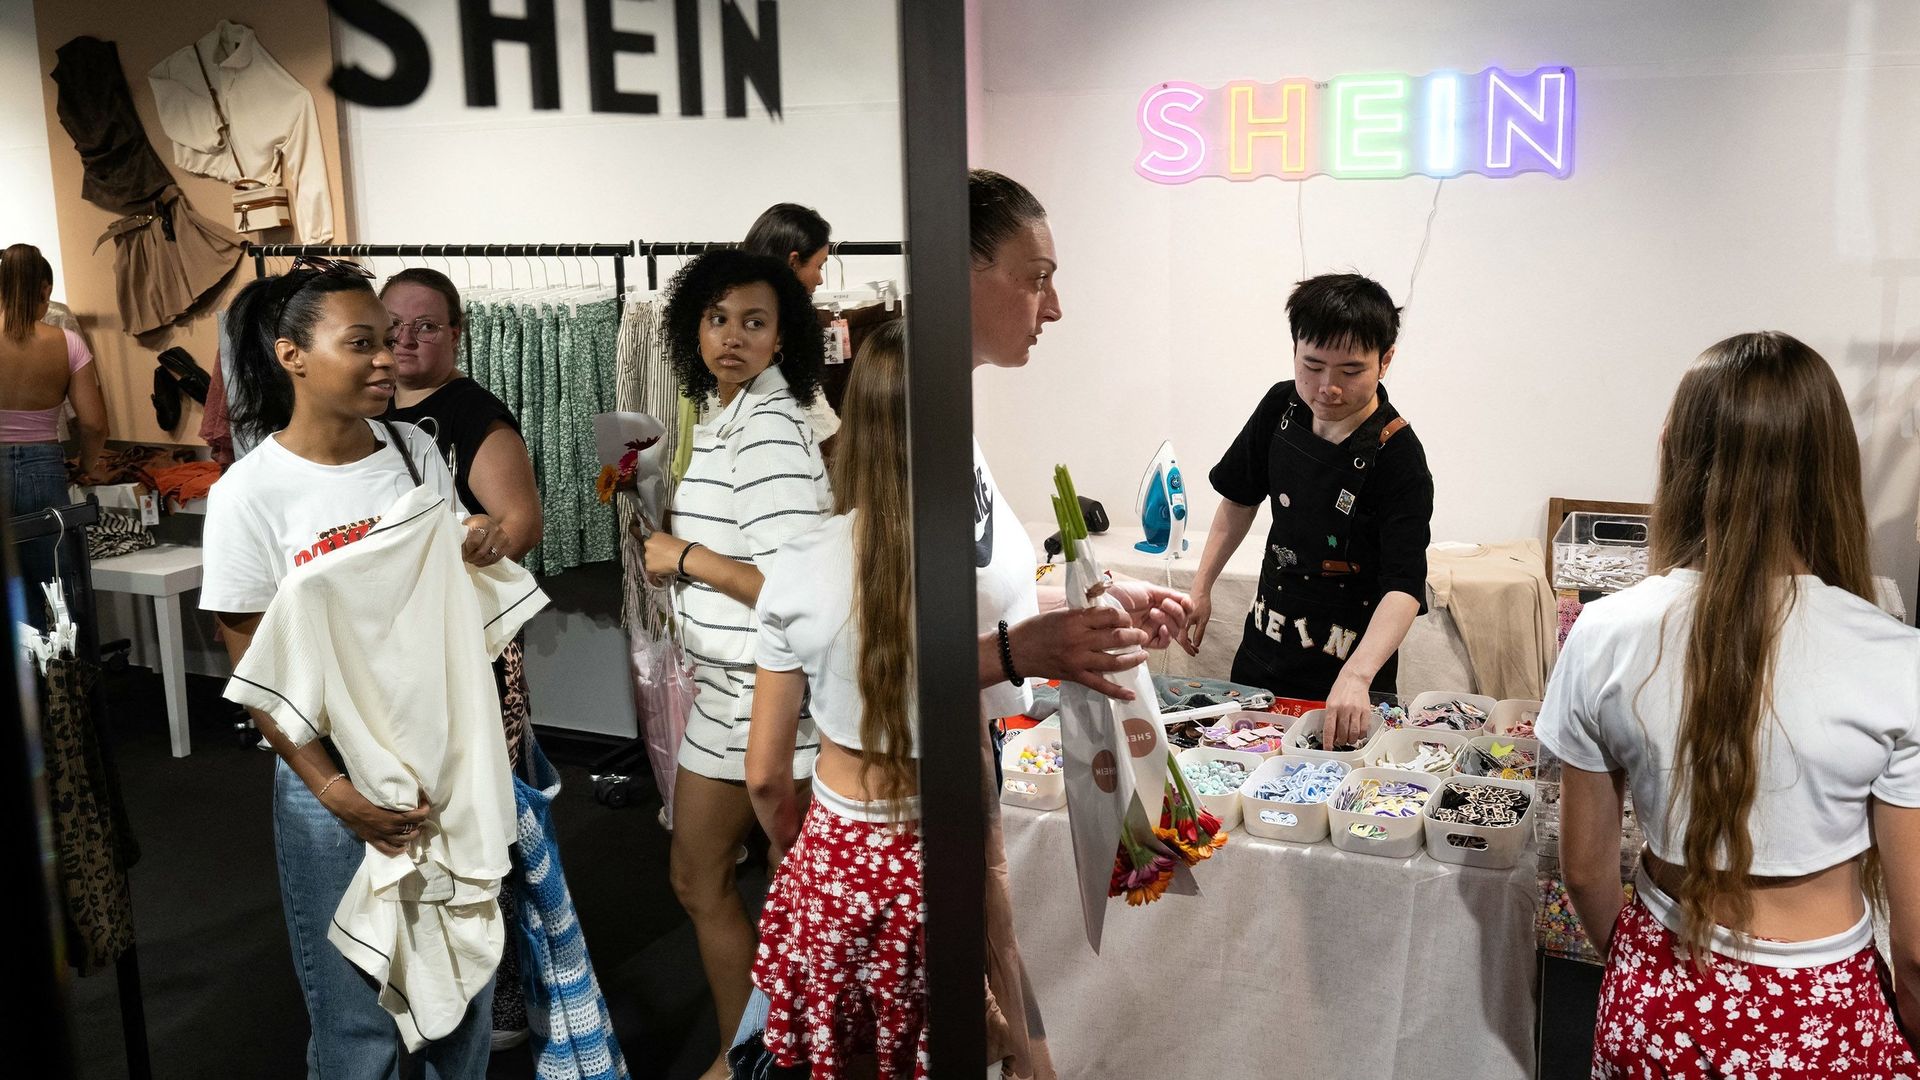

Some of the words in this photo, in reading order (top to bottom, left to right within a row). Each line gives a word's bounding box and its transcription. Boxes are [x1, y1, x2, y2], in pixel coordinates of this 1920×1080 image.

[328, 0, 783, 122] SHEIN
[1138, 72, 1568, 177] SHEIN
[1255, 600, 1358, 661] HEIN
[1127, 732, 1152, 743] SHE
